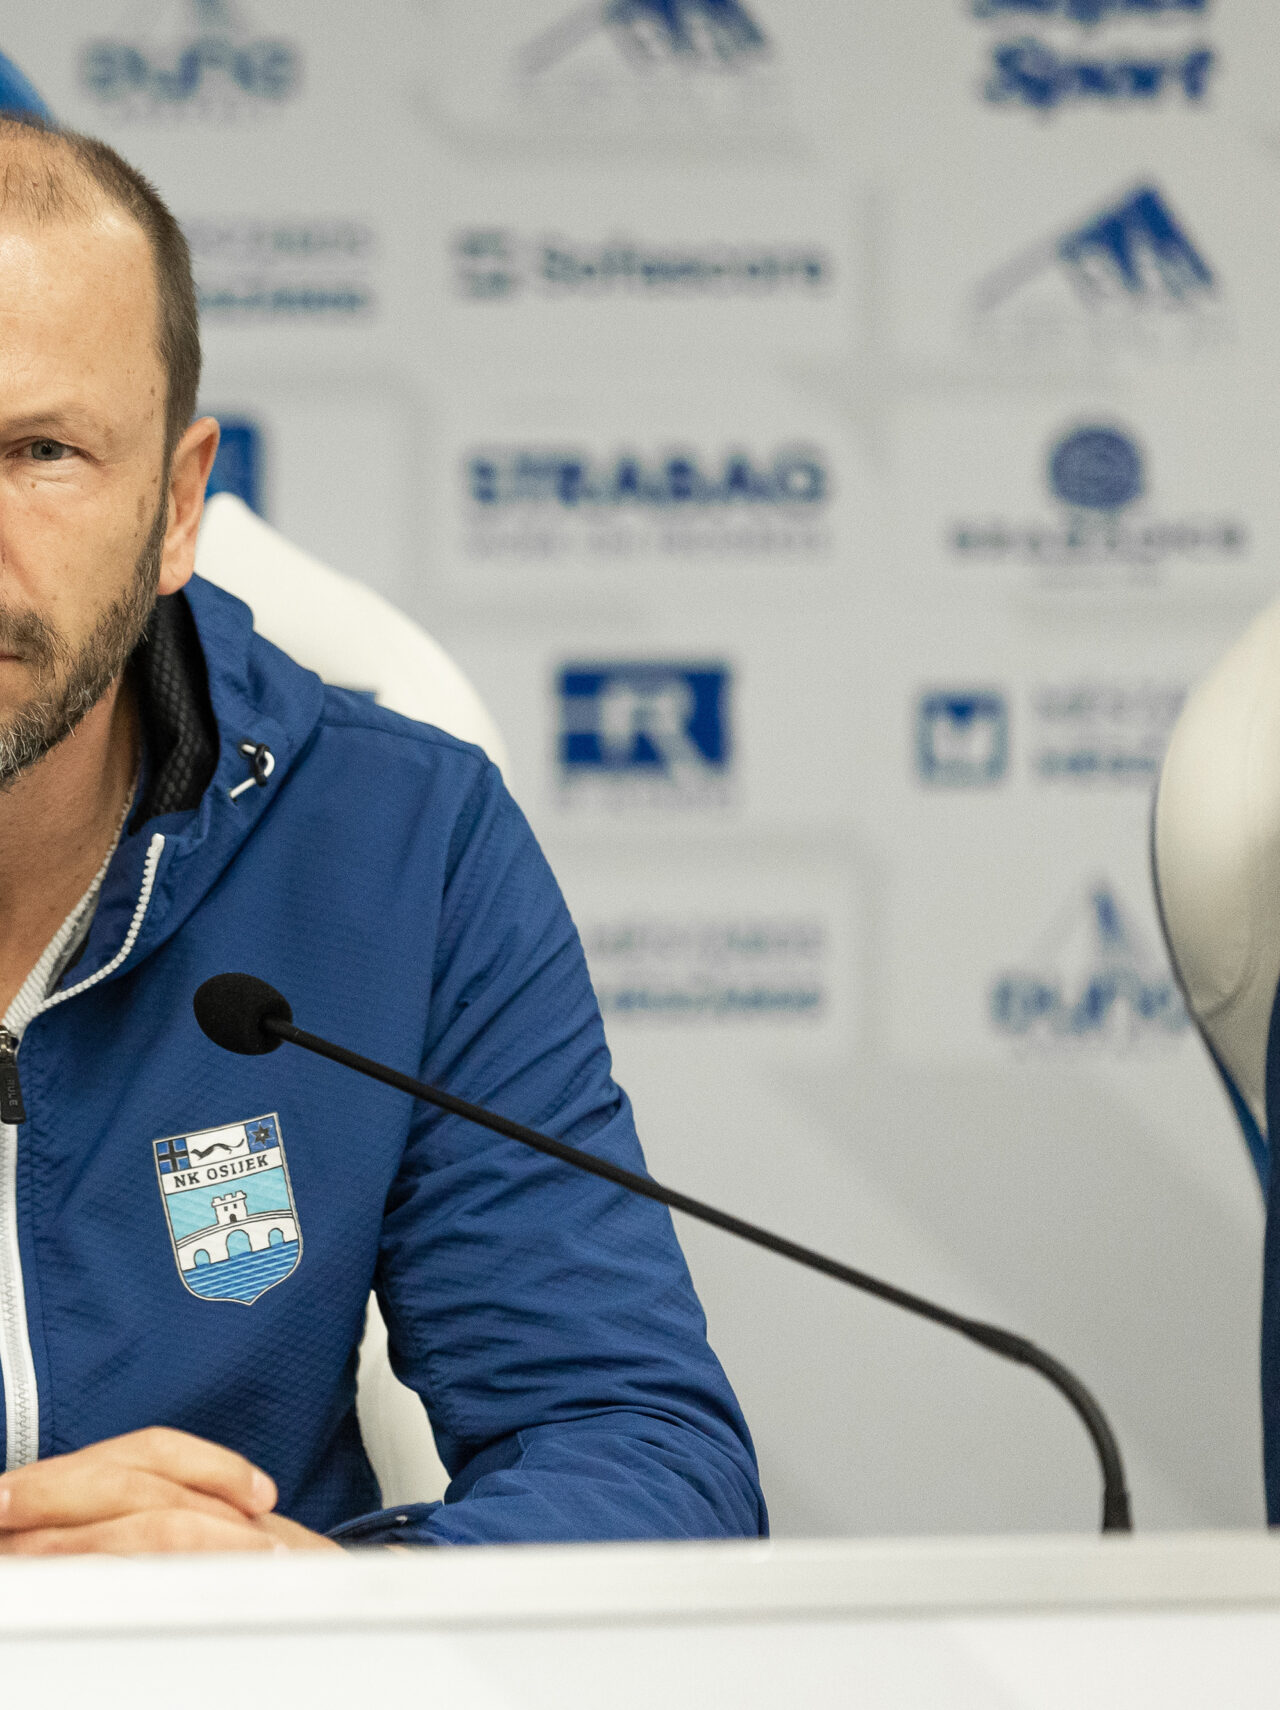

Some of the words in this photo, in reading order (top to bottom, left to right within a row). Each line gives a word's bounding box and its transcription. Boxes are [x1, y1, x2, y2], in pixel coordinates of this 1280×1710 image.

[985, 42, 1214, 116] Sport
[173, 1171, 201, 1188] NK
[206, 1154, 269, 1181] OSIJEK
